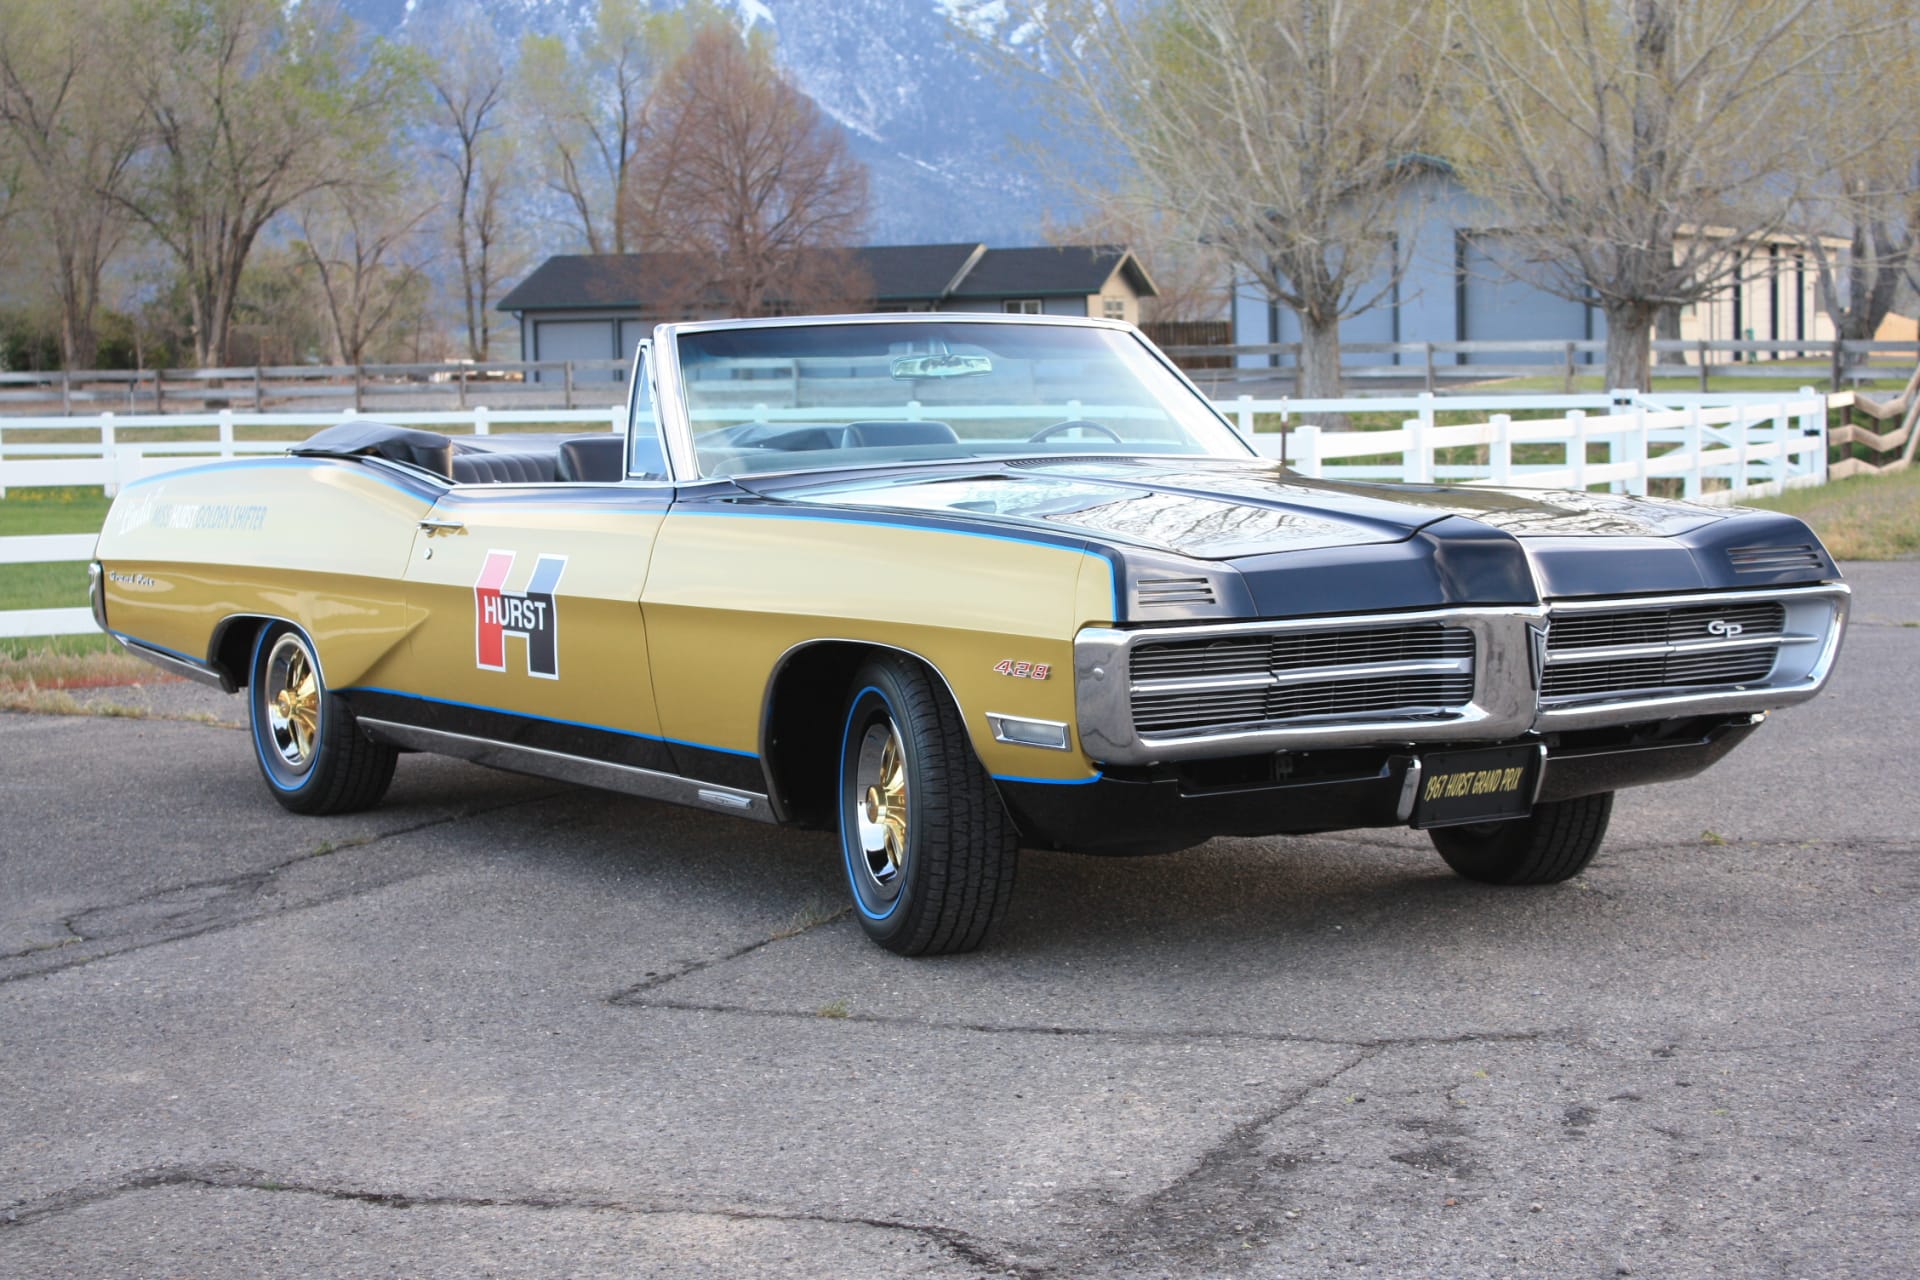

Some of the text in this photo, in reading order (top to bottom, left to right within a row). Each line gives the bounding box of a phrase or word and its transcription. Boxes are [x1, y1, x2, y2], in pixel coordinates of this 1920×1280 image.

[195, 504, 233, 528] GOLDEN
[230, 505, 267, 530] SHIFTER
[483, 595, 546, 631] HURST
[993, 659, 1049, 680] 428
[1424, 767, 1524, 802] 1967 HURST GRAND PRIX
